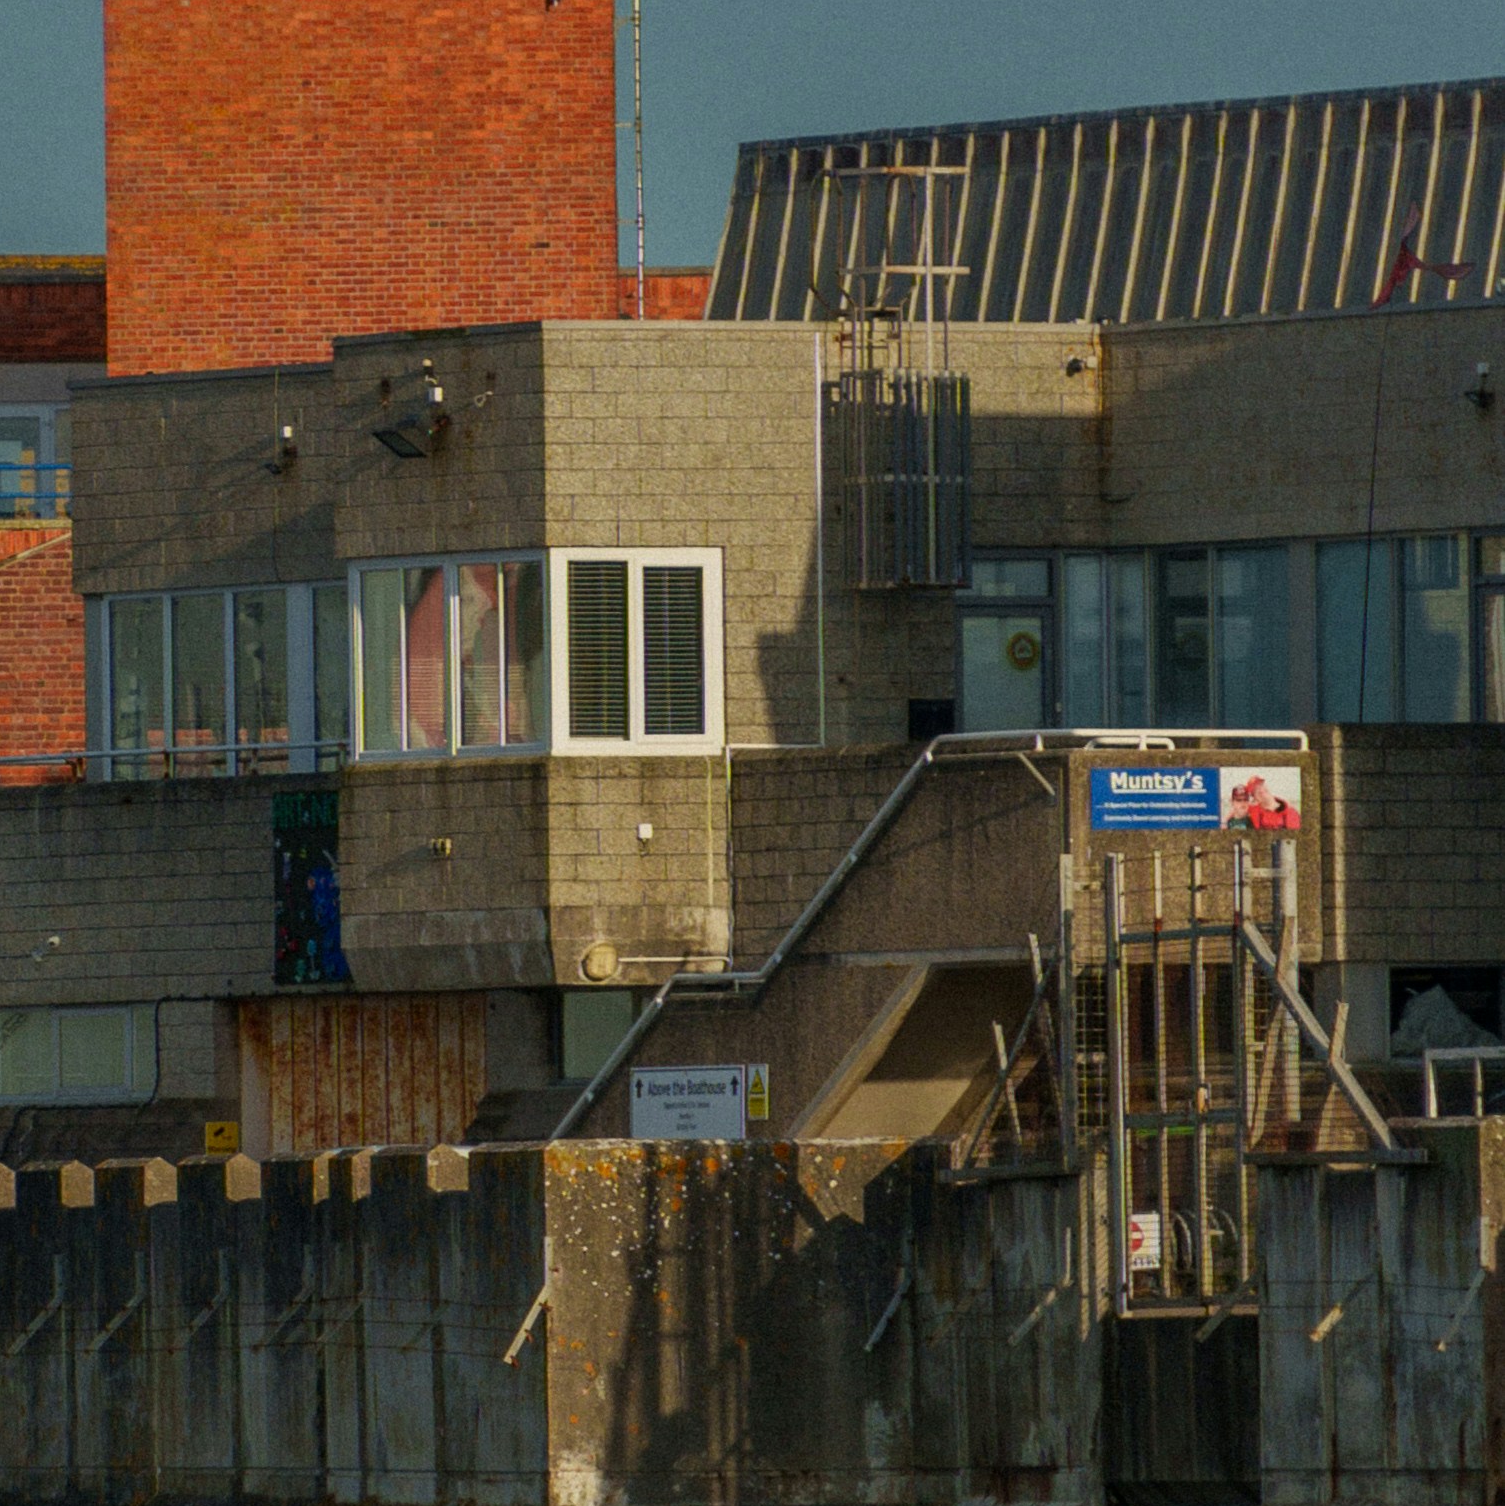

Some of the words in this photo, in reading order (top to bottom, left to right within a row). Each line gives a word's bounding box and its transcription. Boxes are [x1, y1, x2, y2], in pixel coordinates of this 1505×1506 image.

[1110, 770, 1205, 793] Muntsy's
[648, 1080, 671, 1095] Above
[672, 1079, 686, 1095] the
[687, 1079, 727, 1095] Boathouse
